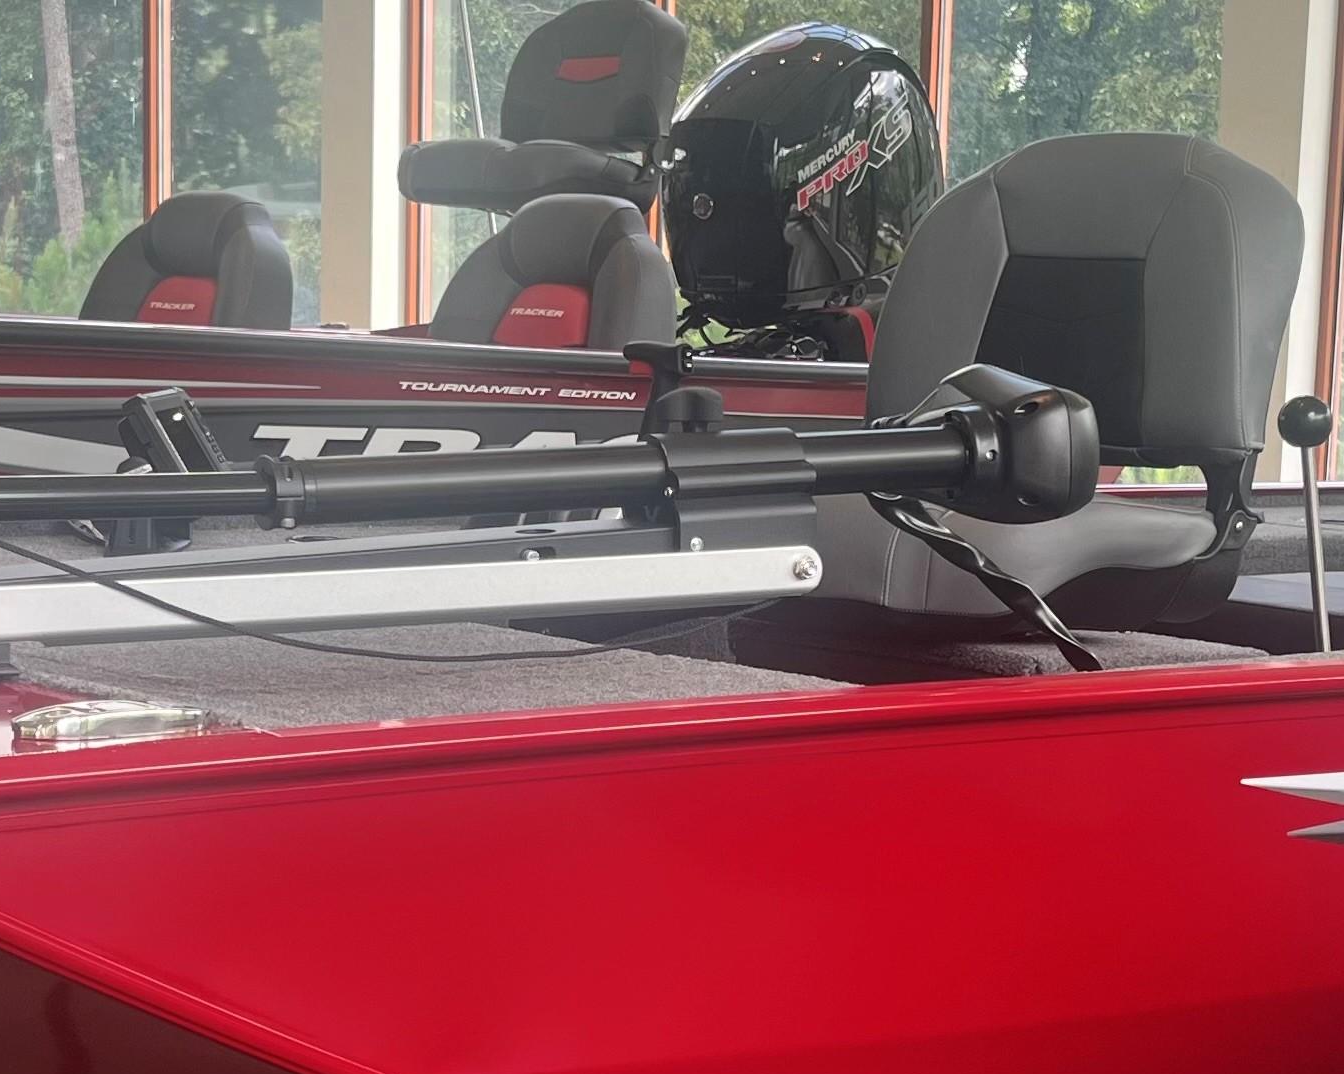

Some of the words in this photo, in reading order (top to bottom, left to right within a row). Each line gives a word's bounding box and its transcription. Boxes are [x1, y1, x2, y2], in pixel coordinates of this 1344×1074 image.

[797, 128, 856, 184] MERCURY
[150, 301, 195, 311] TRACKER
[510, 307, 565, 318] TRACKER
[399, 380, 551, 397] TOURNAMENT
[557, 388, 637, 401] EDITION
